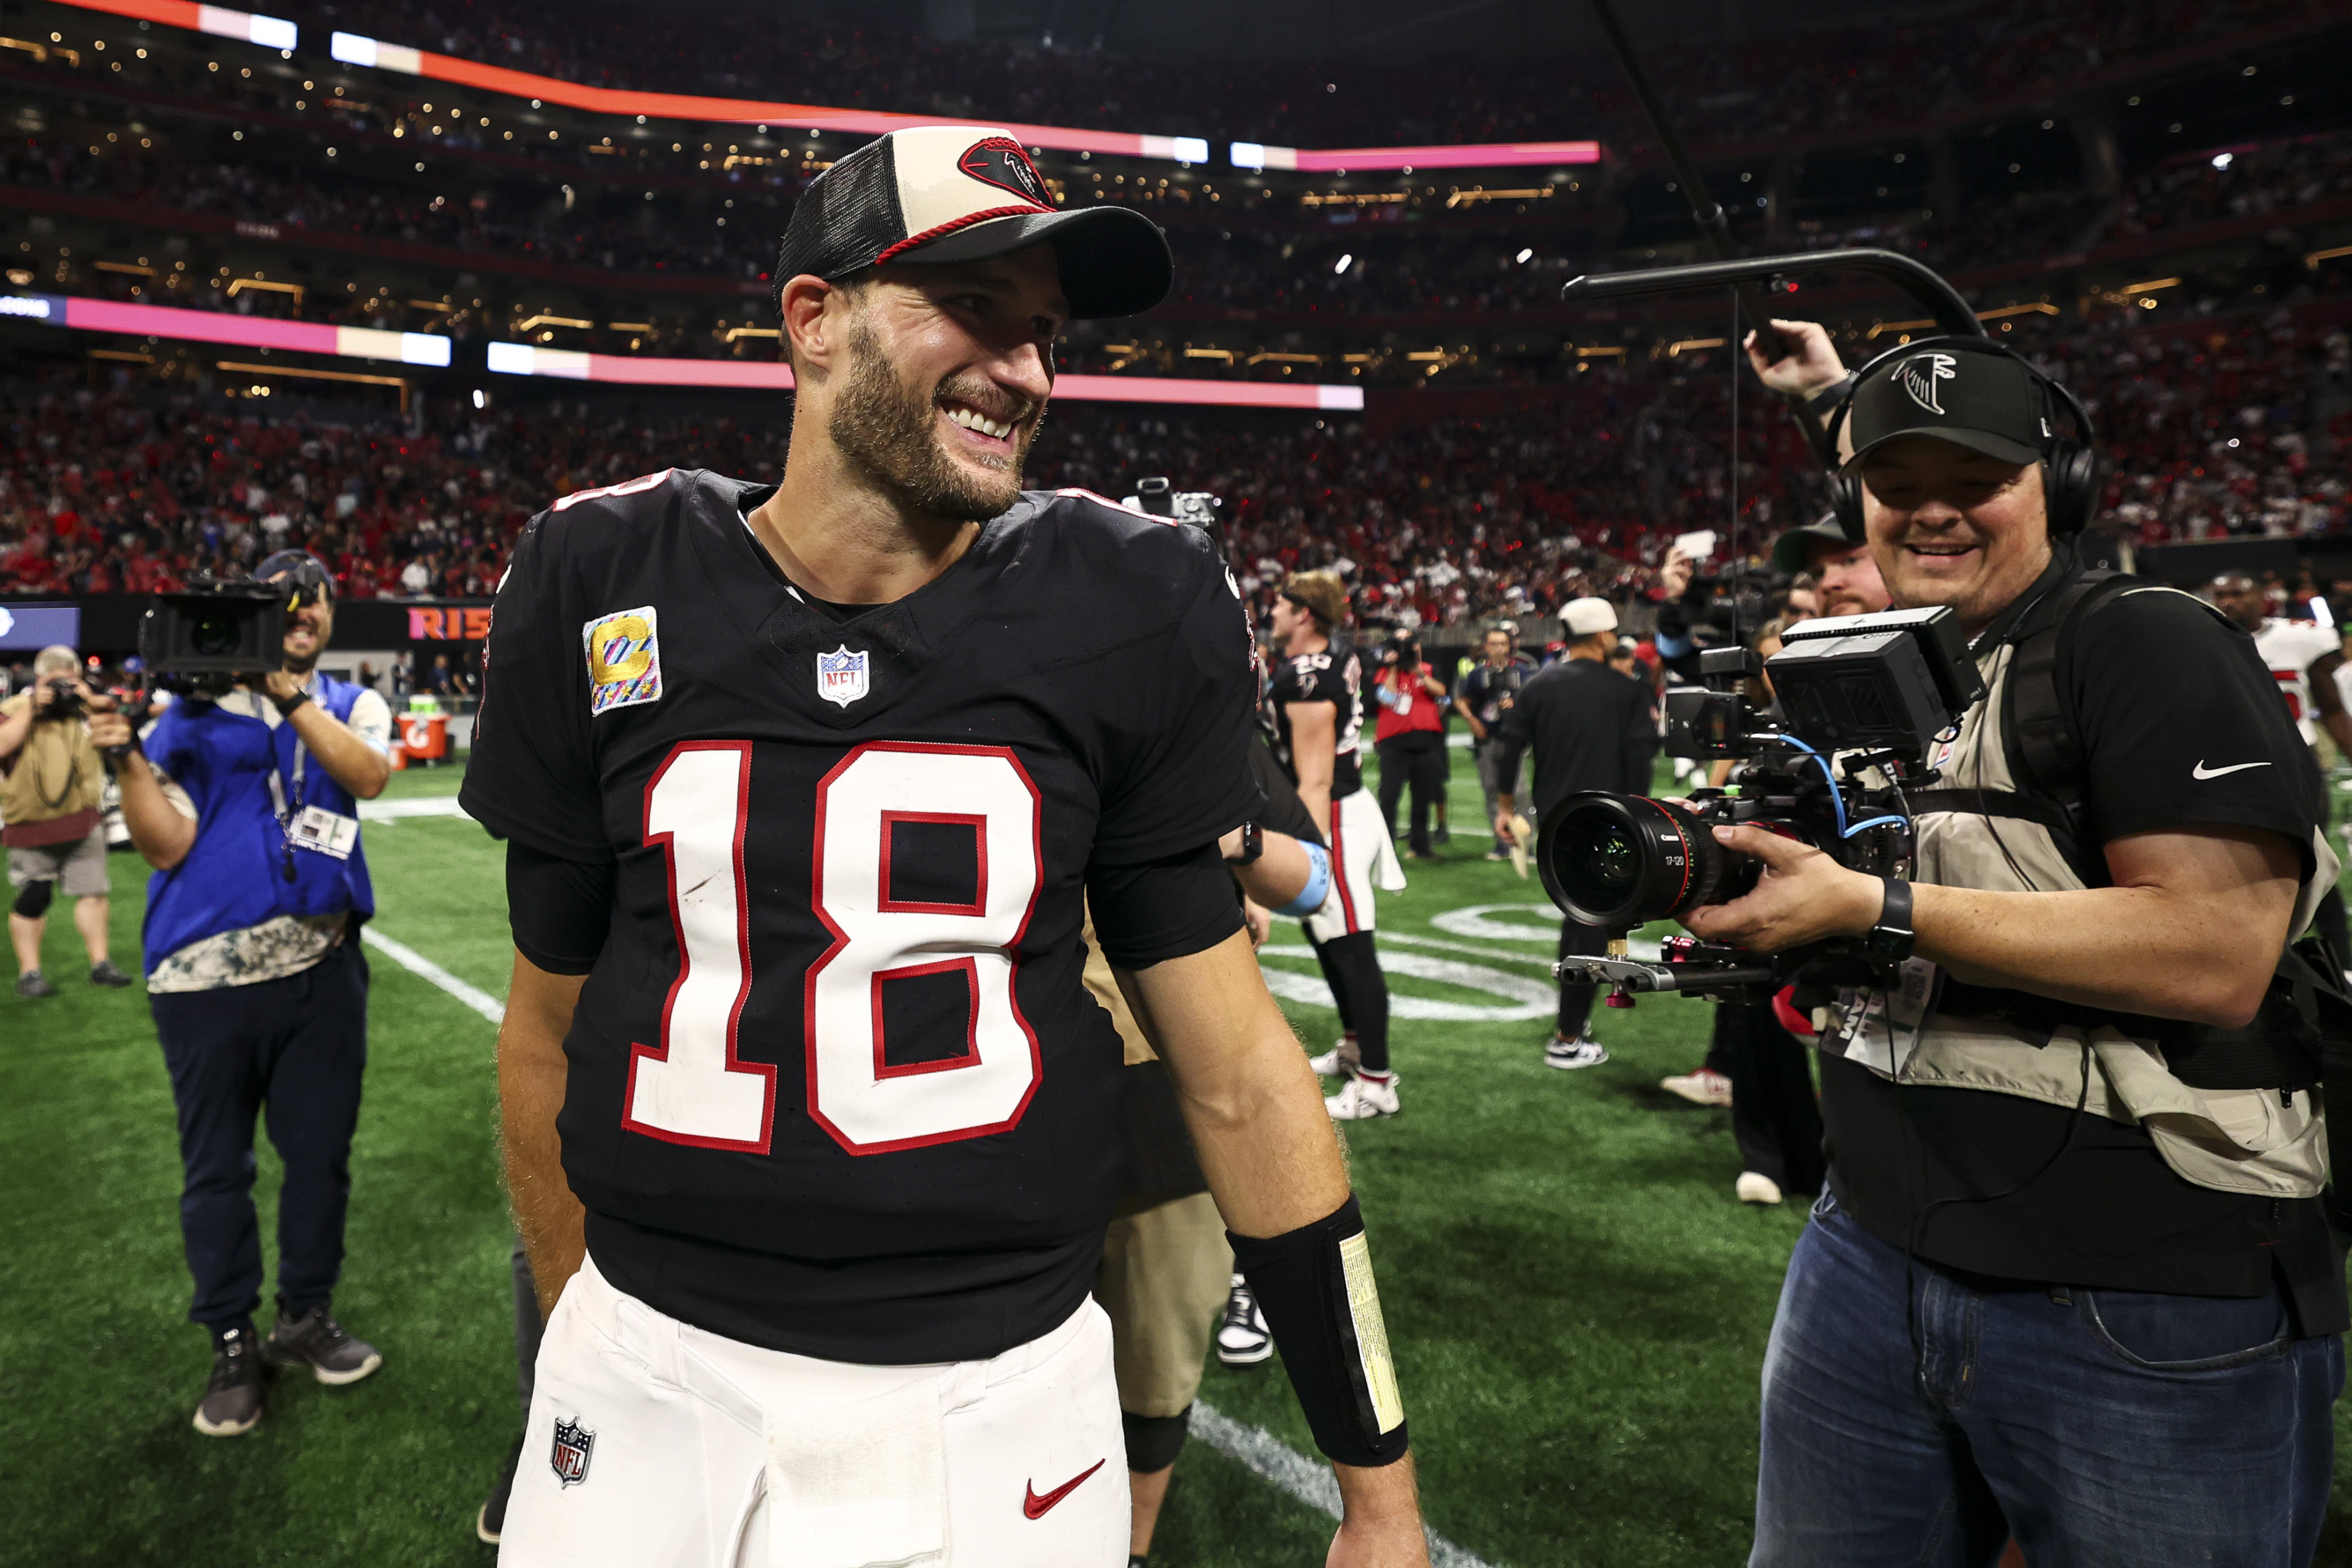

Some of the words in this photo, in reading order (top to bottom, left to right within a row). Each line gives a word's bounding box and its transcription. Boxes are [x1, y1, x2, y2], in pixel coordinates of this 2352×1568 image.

[408, 606, 492, 640] RIS
[590, 616, 649, 687] C
[826, 672, 860, 689] NFL
[1665, 856, 1684, 865] 17-120
[621, 739, 1044, 1156] 18
[554, 1443, 581, 1476] NFL
